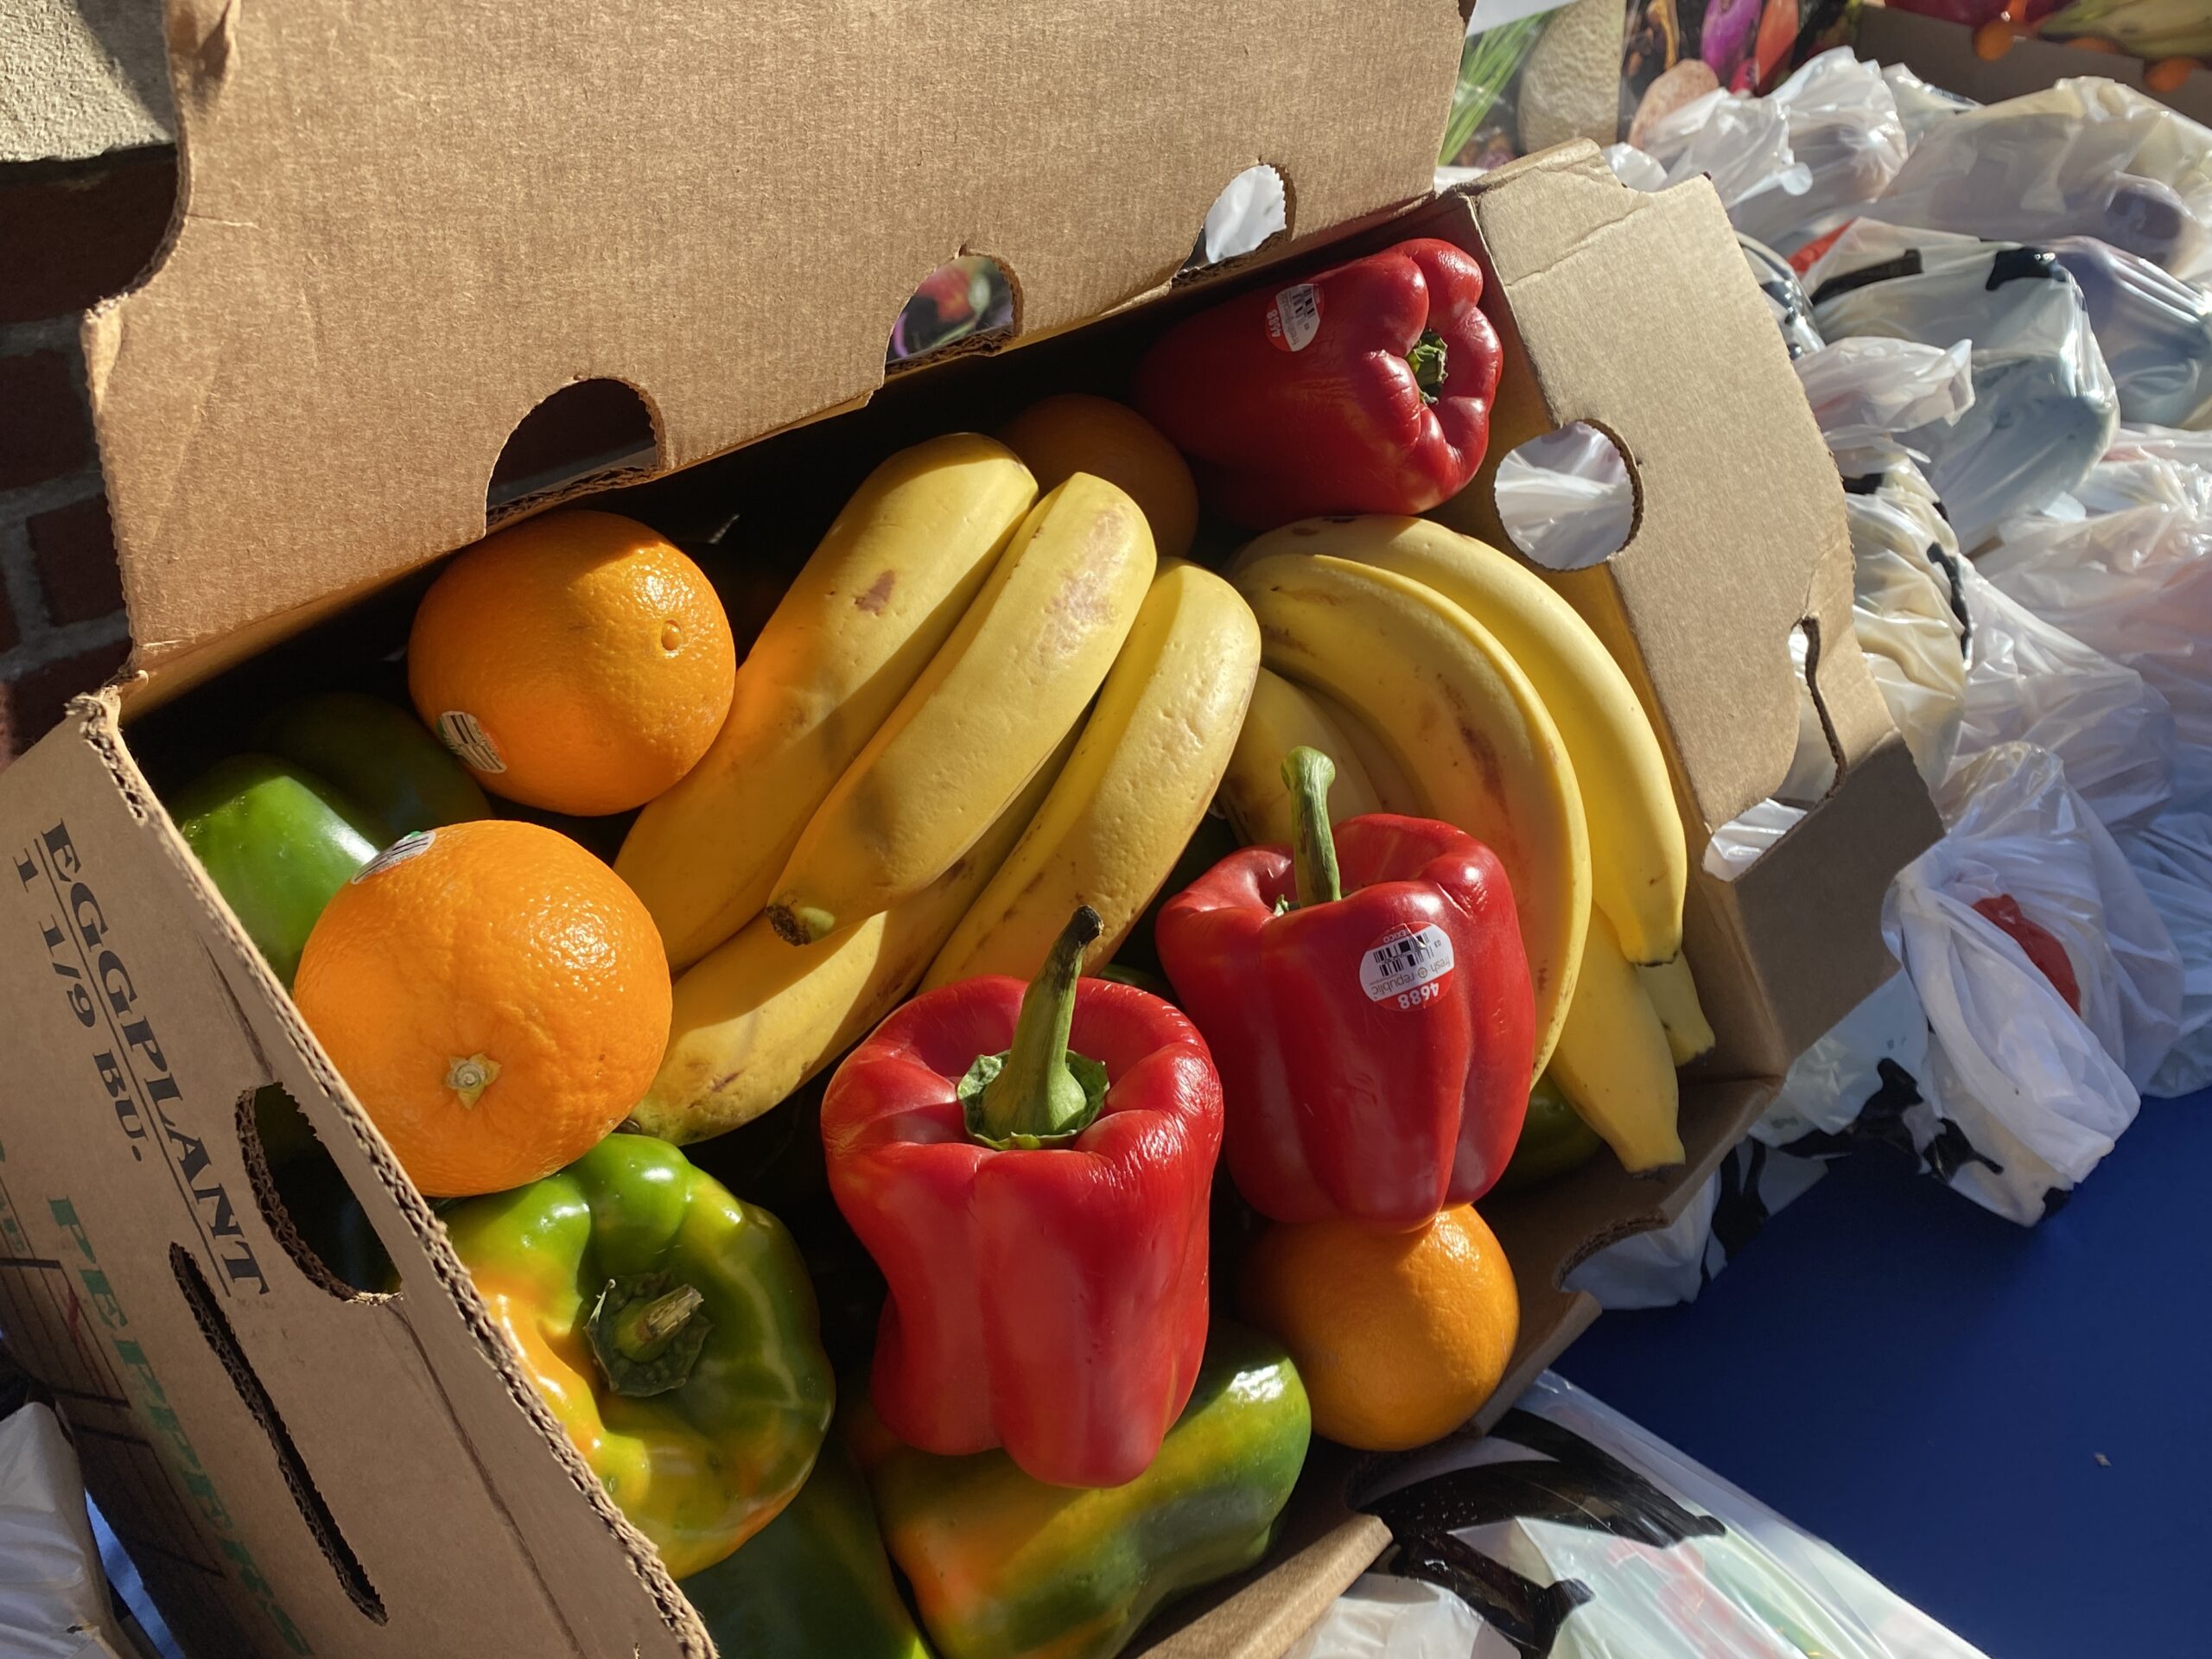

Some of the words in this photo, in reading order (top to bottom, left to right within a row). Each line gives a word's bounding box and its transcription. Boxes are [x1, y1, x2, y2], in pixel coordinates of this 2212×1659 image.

[1267, 309, 1281, 338] 4688
[1430, 956, 1451, 974] fresh
[1370, 972, 1415, 995] republic
[1397, 982, 1440, 1010] 4688
[12, 847, 40, 893] 1
[37, 913, 97, 1028] 1/9
[92, 1047, 150, 1163] BU.
[42, 817, 270, 1296] EGGPLANT
[46, 1196, 315, 1657] PEPPERS
